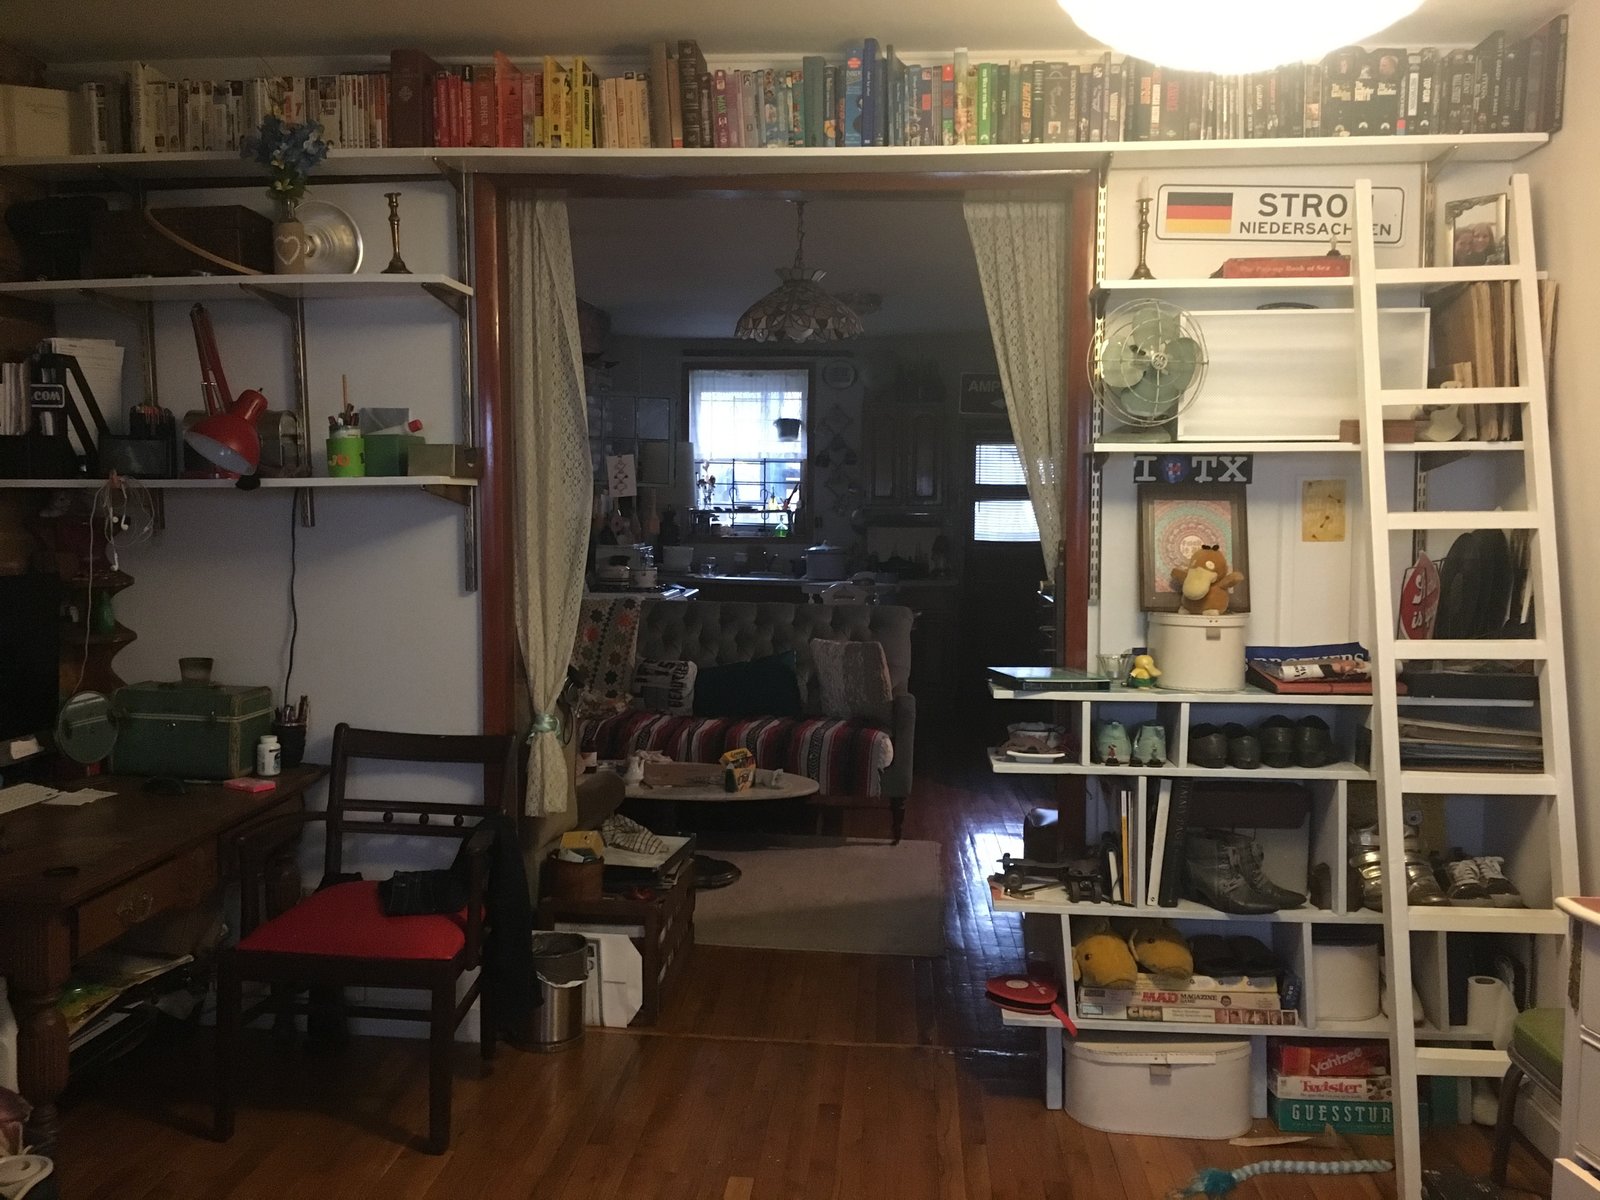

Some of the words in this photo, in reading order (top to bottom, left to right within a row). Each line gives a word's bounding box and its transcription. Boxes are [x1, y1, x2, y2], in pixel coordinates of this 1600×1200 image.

[1258, 193, 1374, 218] STRO
[1239, 221, 1392, 236] NIEDERSACHEN
[1135, 456, 1157, 481] I
[1191, 456, 1248, 482] TX
[1141, 992, 1178, 1003] MAD
[1311, 1048, 1362, 1075] Yahtzee
[1300, 1080, 1363, 1094] Twister
